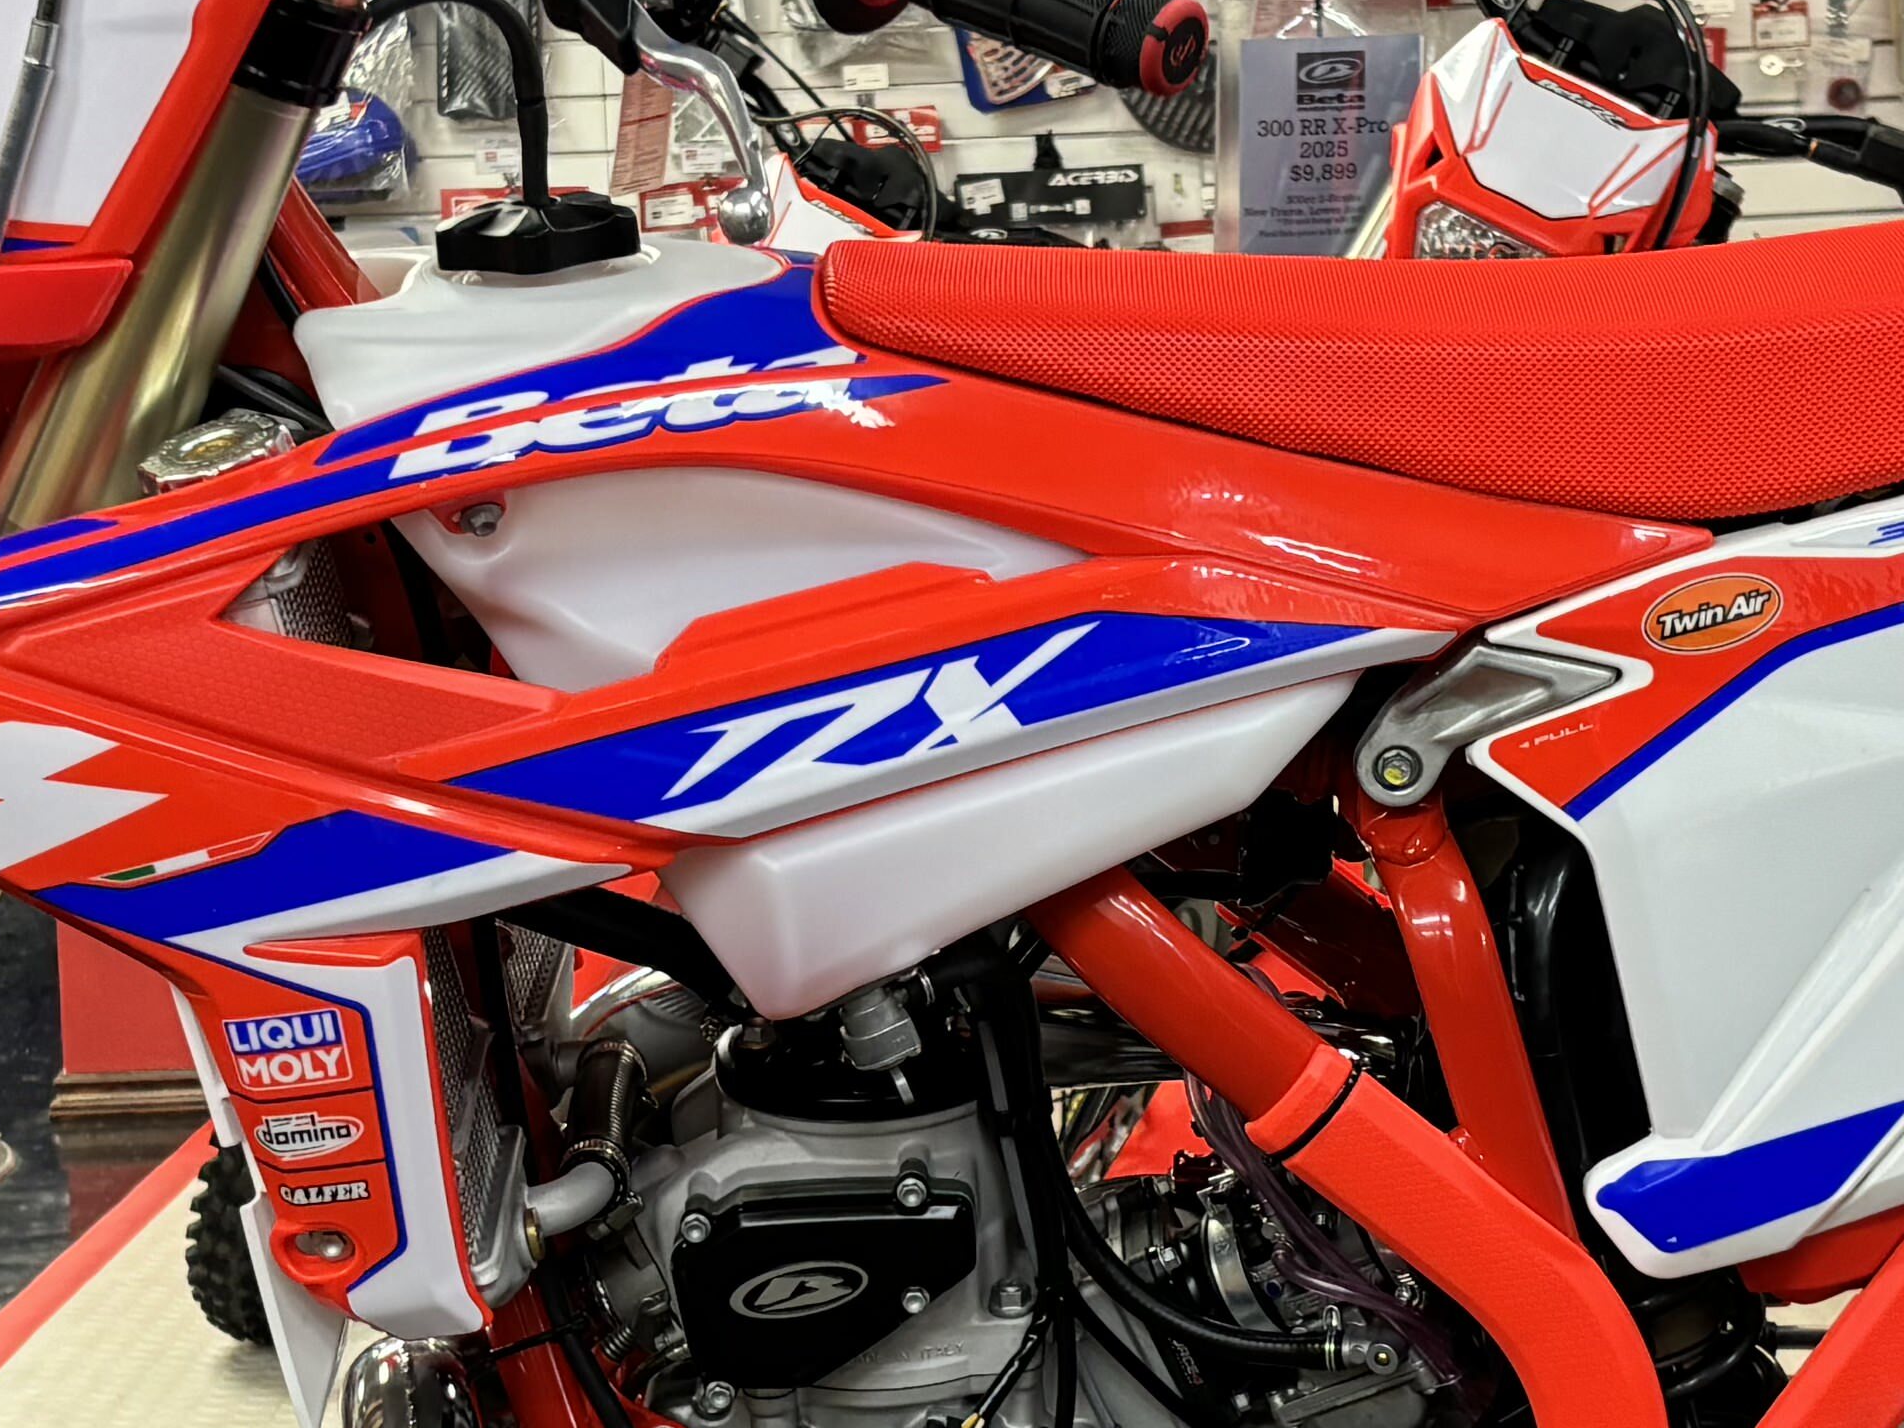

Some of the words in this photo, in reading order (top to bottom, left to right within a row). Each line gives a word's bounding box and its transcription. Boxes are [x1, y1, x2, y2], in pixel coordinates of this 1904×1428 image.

[1257, 120, 1294, 137] 300
[1299, 119, 1327, 136] RR
[1332, 117, 1390, 134] X-Pro
[1299, 140, 1349, 158] 2025
[1046, 169, 1140, 188] ACERBIS
[1289, 163, 1358, 183] $9,899
[388, 346, 861, 480] Beta
[1658, 600, 1725, 639] Twin
[1725, 587, 1772, 624] Air
[1533, 719, 1594, 748] PULL
[227, 1011, 338, 1053] LIQUI
[237, 1047, 344, 1087] MOLY
[260, 1113, 353, 1145] domino
[279, 1181, 370, 1205] GALFER
